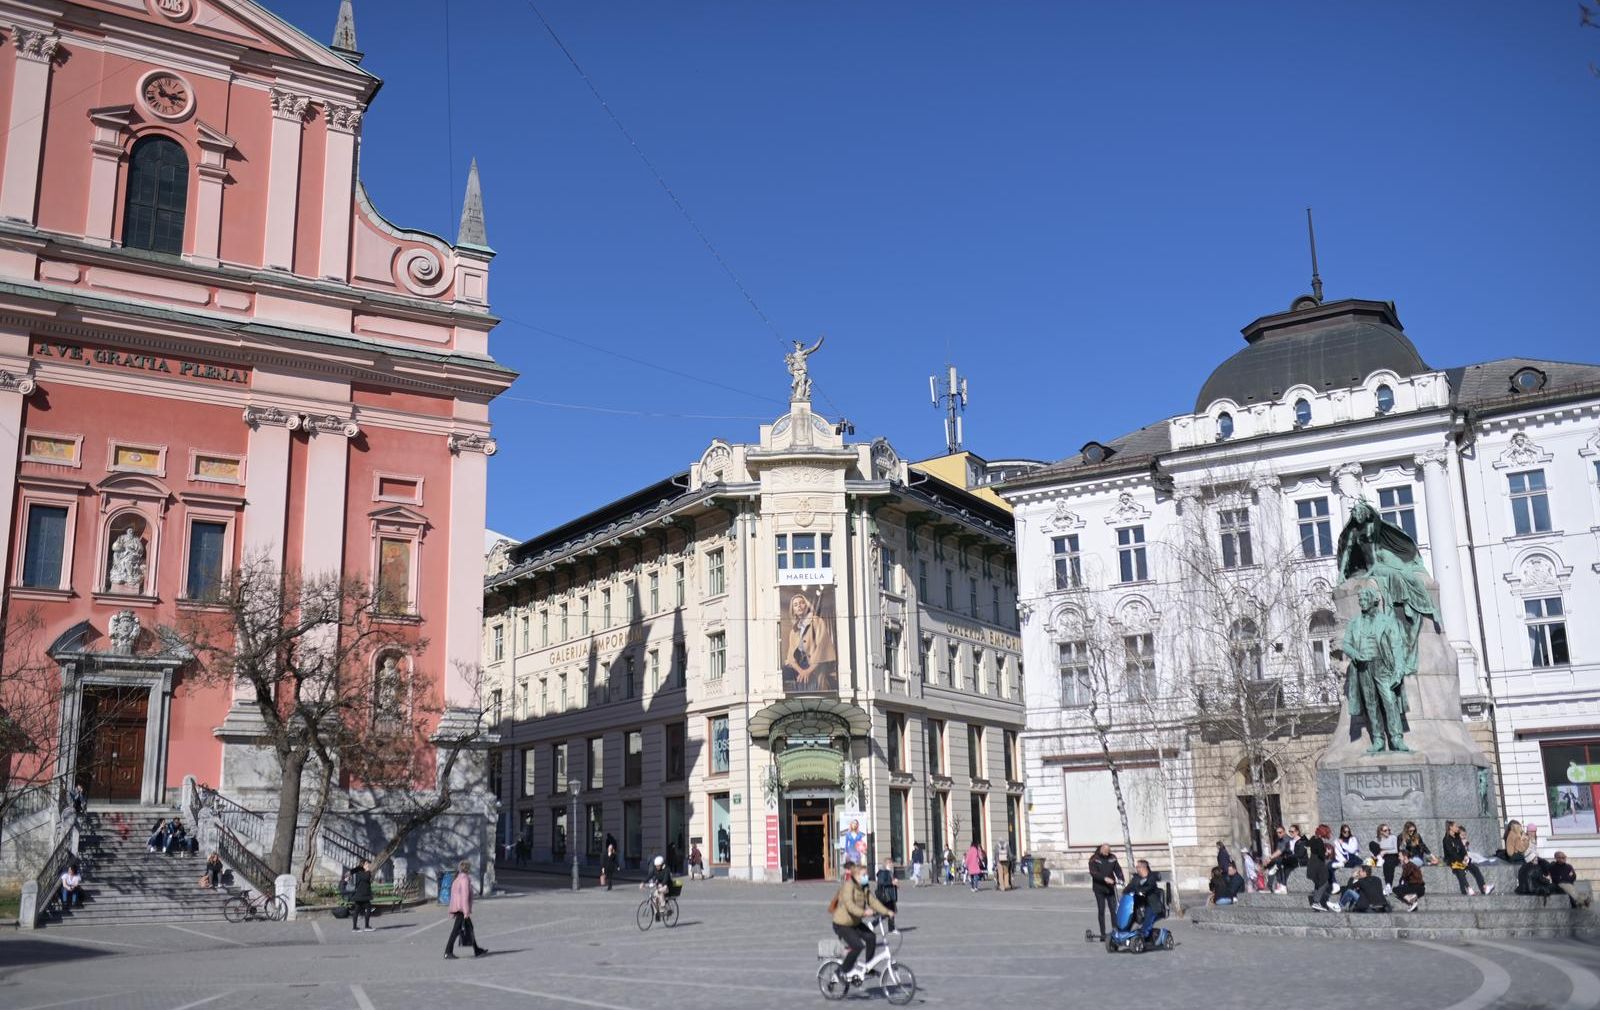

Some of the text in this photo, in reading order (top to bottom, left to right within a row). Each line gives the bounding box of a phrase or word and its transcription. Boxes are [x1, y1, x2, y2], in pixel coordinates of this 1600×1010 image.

[37, 342, 249, 384] AVE, GRATIA PLENA!
[549, 627, 643, 665] GALERIJA EMPORIUM
